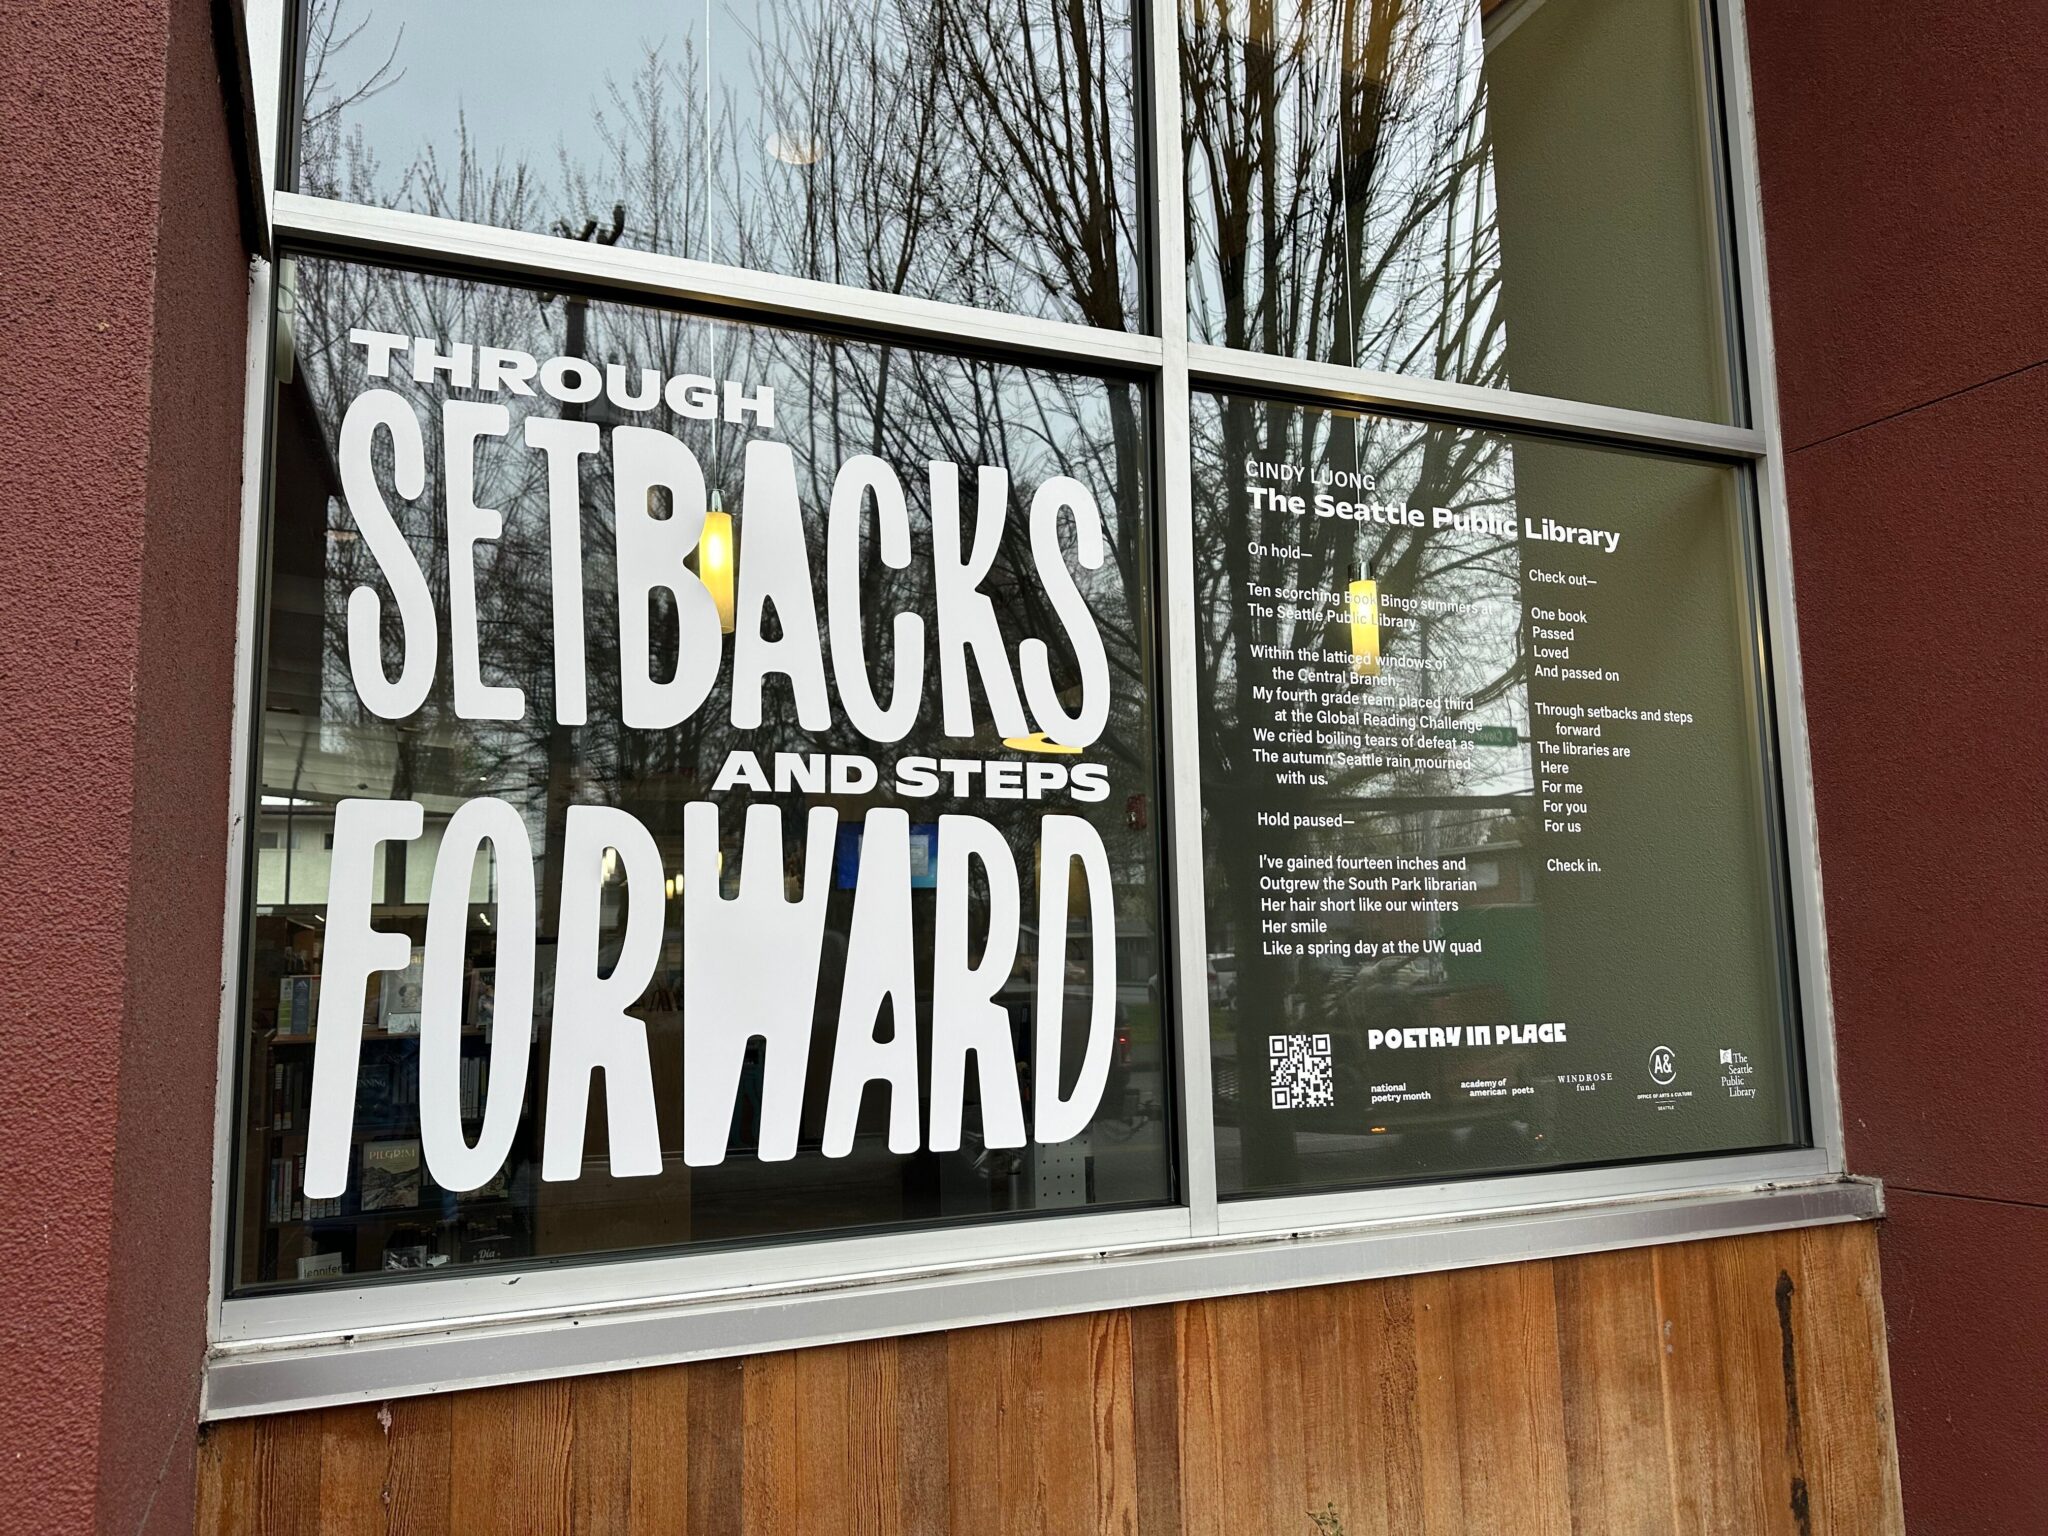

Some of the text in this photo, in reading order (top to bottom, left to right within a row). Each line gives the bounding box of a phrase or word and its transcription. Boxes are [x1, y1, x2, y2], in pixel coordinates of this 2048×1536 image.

[349, 328, 775, 428] THROUGH
[1246, 461, 1376, 491] CINDY LUONG
[1246, 487, 1620, 553] The Seattle Public Library
[1248, 542, 1267, 556] On
[338, 387, 1111, 748] SETBACKS
[1528, 568, 1565, 584] Check
[1246, 582, 1492, 614] Ten scorching Book Bingo summers at
[1247, 603, 1416, 631] The Seattle Public Library
[1531, 607, 1588, 623] One book
[1532, 626, 1574, 640] Passed
[1250, 644, 1447, 670] Within the latticed windows of
[1533, 645, 1569, 659] Loved
[1272, 666, 1399, 688] the Central Branch,
[1534, 664, 1620, 682] And passed on
[1252, 686, 1473, 711] My fourth grade team placed third
[1275, 709, 1482, 733] at the Global Reading Challenge
[1534, 702, 1693, 725] Through setbacks and steps
[1555, 722, 1601, 737] forward
[1253, 727, 1474, 750] We cried boiling tears of defeat as
[1537, 741, 1630, 757] The libraries are
[1252, 748, 1471, 770] The autumn Seattle rain mourned
[1540, 761, 1569, 774] Here
[711, 751, 1111, 801] AND STEPS
[1276, 770, 1328, 785] with us.
[1542, 780, 1583, 793] For me
[1543, 800, 1587, 816] For you
[1257, 812, 1289, 826] Hold
[1544, 819, 1582, 833] For us
[1259, 854, 1466, 872] I've gained fourteen inches and
[1546, 859, 1601, 872] Check in.
[1260, 876, 1477, 893] Outgrew the South Park librarian
[1261, 897, 1459, 911] Her hair short like our winters
[1262, 918, 1327, 933] Her smile
[1263, 939, 1482, 958] Like a spring day at the UW quad
[302, 796, 1117, 1199] FORWARD
[1367, 1026, 1462, 1050] POETRY
[1495, 1023, 1567, 1045] PLACE
[1733, 1052, 1748, 1063] The
[1728, 1065, 1753, 1074] Seattle
[1461, 1078, 1507, 1089] academy of
[1557, 1073, 1613, 1083] WINDROSE
[1721, 1076, 1744, 1086] Public
[1371, 1083, 1406, 1093] national
[1469, 1086, 1534, 1097] american poets
[1576, 1083, 1595, 1092] fund
[1729, 1087, 1756, 1098] Library
[1371, 1091, 1431, 1104] poetry month
[369, 1148, 415, 1160] PILGRIM
